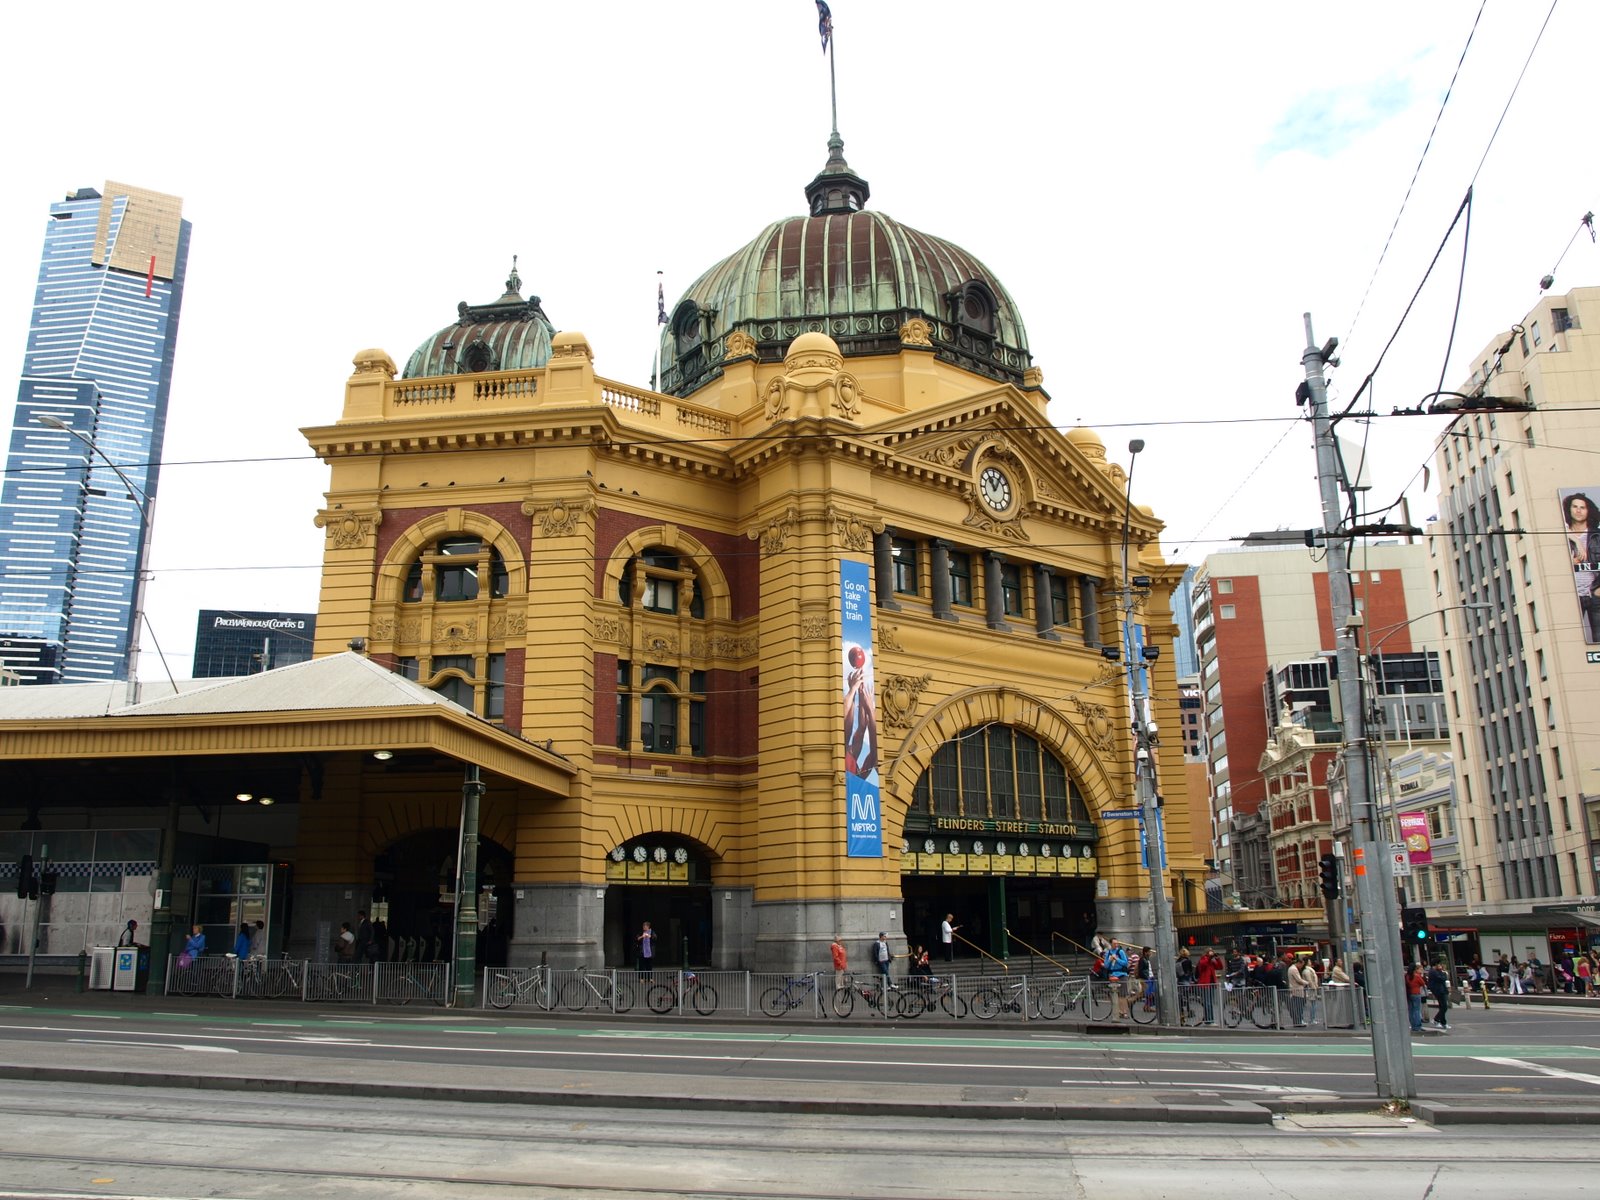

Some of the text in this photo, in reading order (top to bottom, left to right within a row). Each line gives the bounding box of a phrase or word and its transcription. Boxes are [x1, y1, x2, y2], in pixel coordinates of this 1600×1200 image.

[844, 580, 867, 592] Go on,
[845, 591, 861, 601] take
[845, 601, 858, 610] the
[845, 611, 863, 621] train
[851, 822, 878, 833] METRO
[937, 817, 1077, 835] FLINDERS STREET STATION
